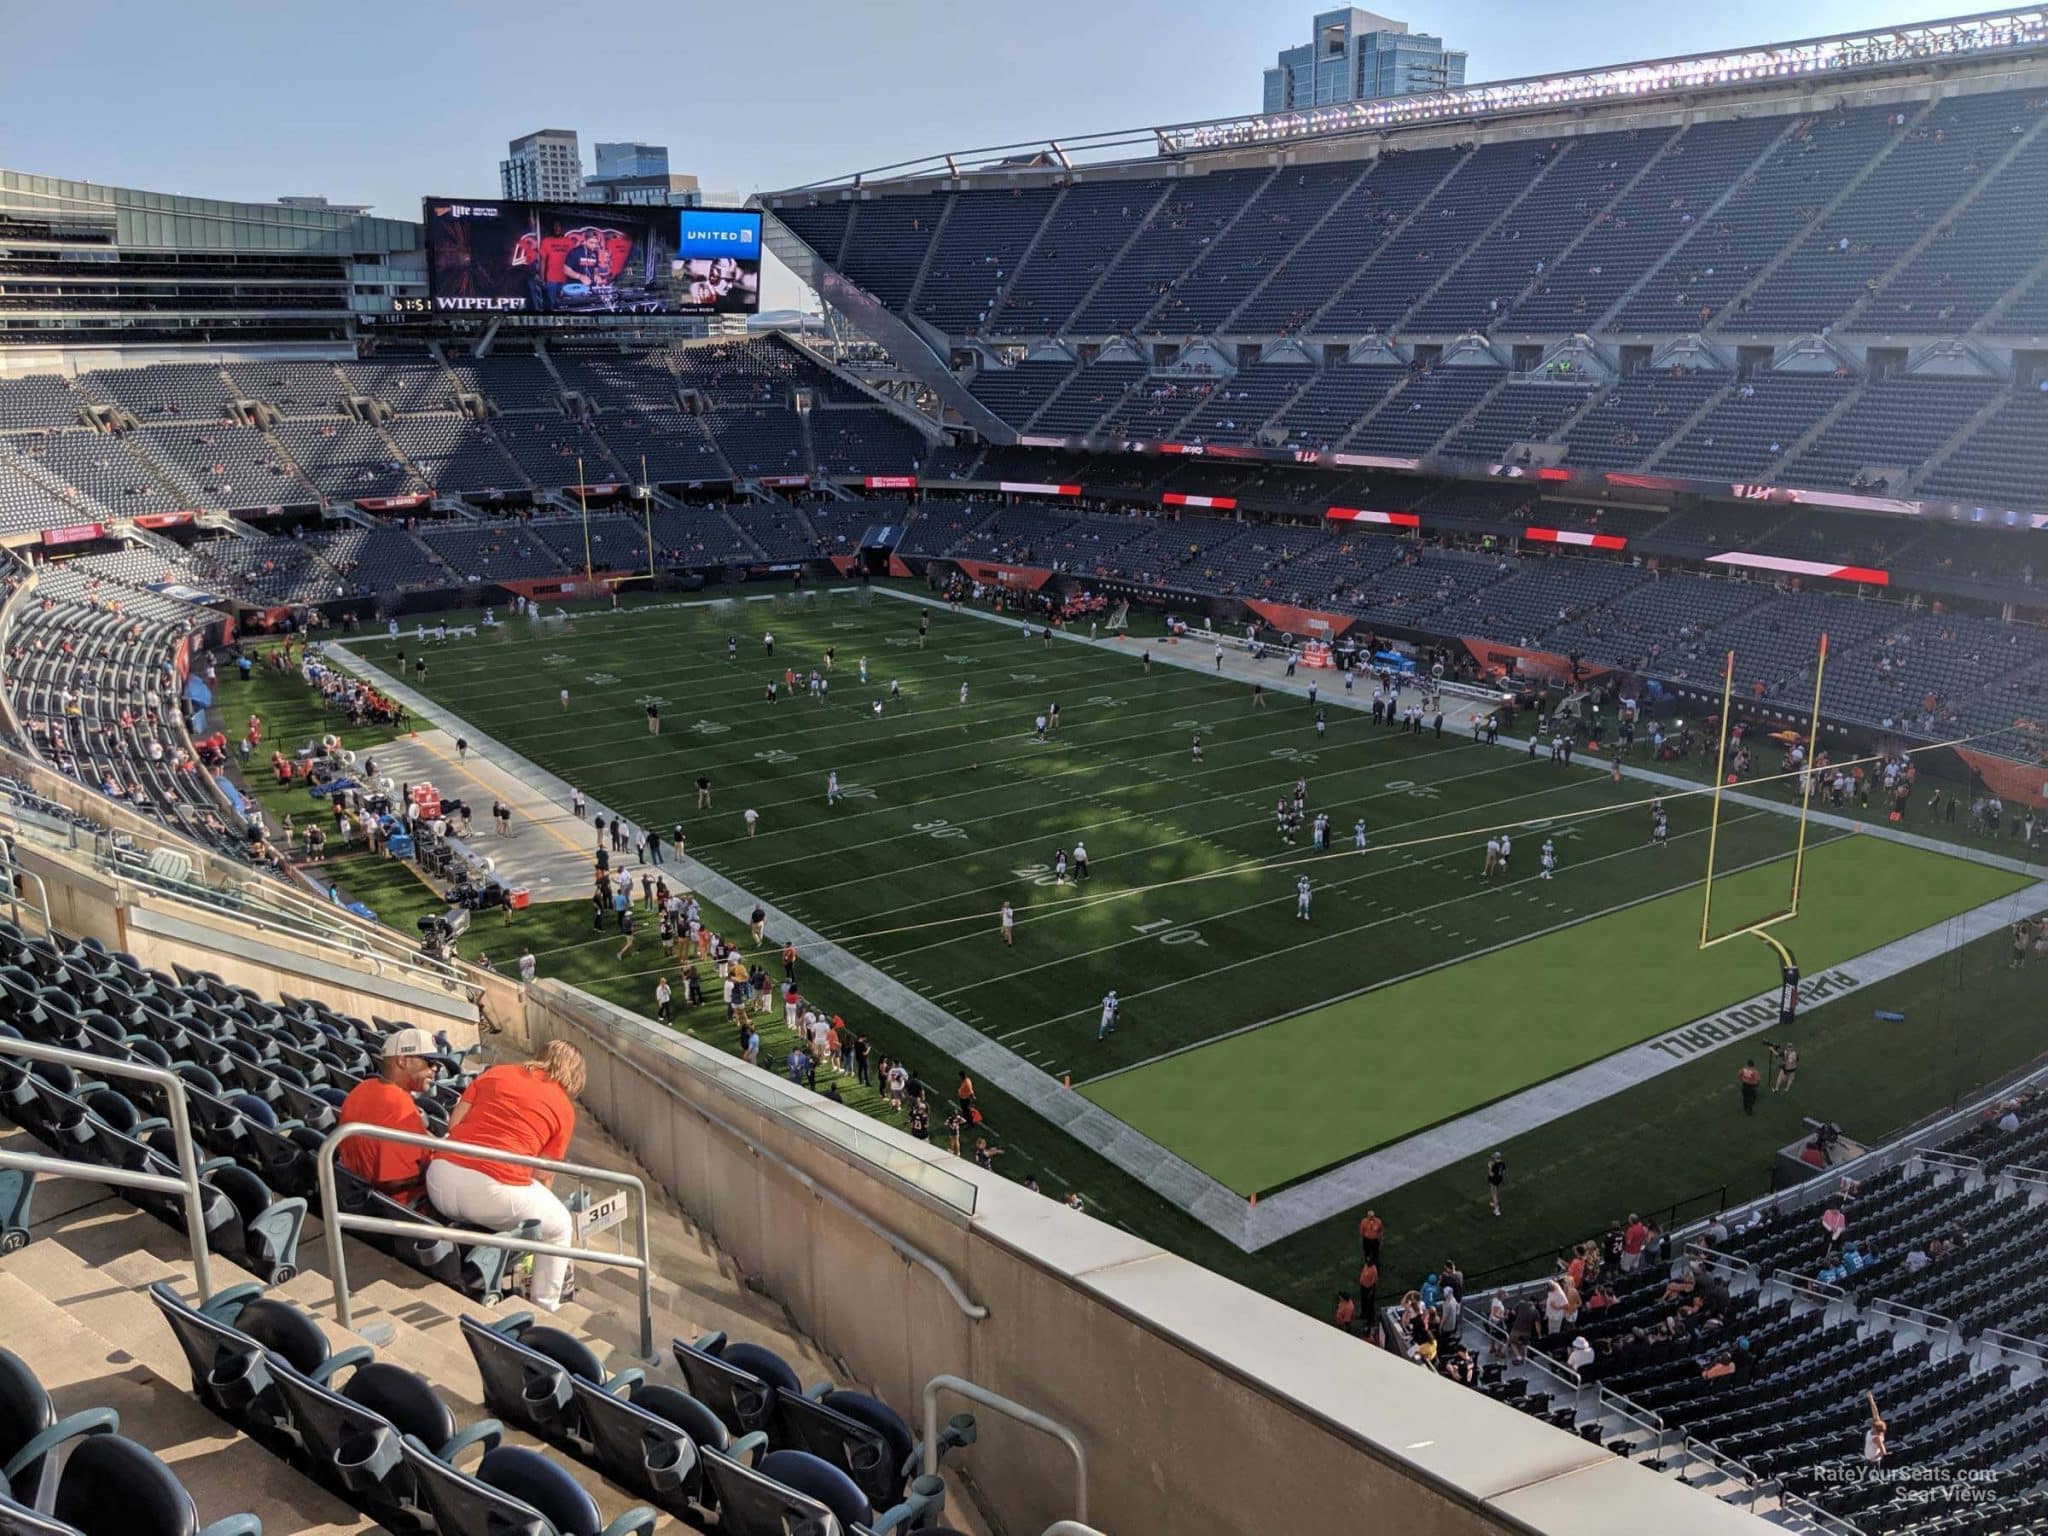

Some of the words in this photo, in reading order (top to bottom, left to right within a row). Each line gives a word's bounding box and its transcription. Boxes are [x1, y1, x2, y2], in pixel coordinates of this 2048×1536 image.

[688, 232, 737, 240] UNITED
[912, 819, 965, 838] 30
[1130, 917, 1201, 945] 10
[1650, 998, 1782, 1059] FOOTBALL
[589, 1200, 616, 1222] 301
